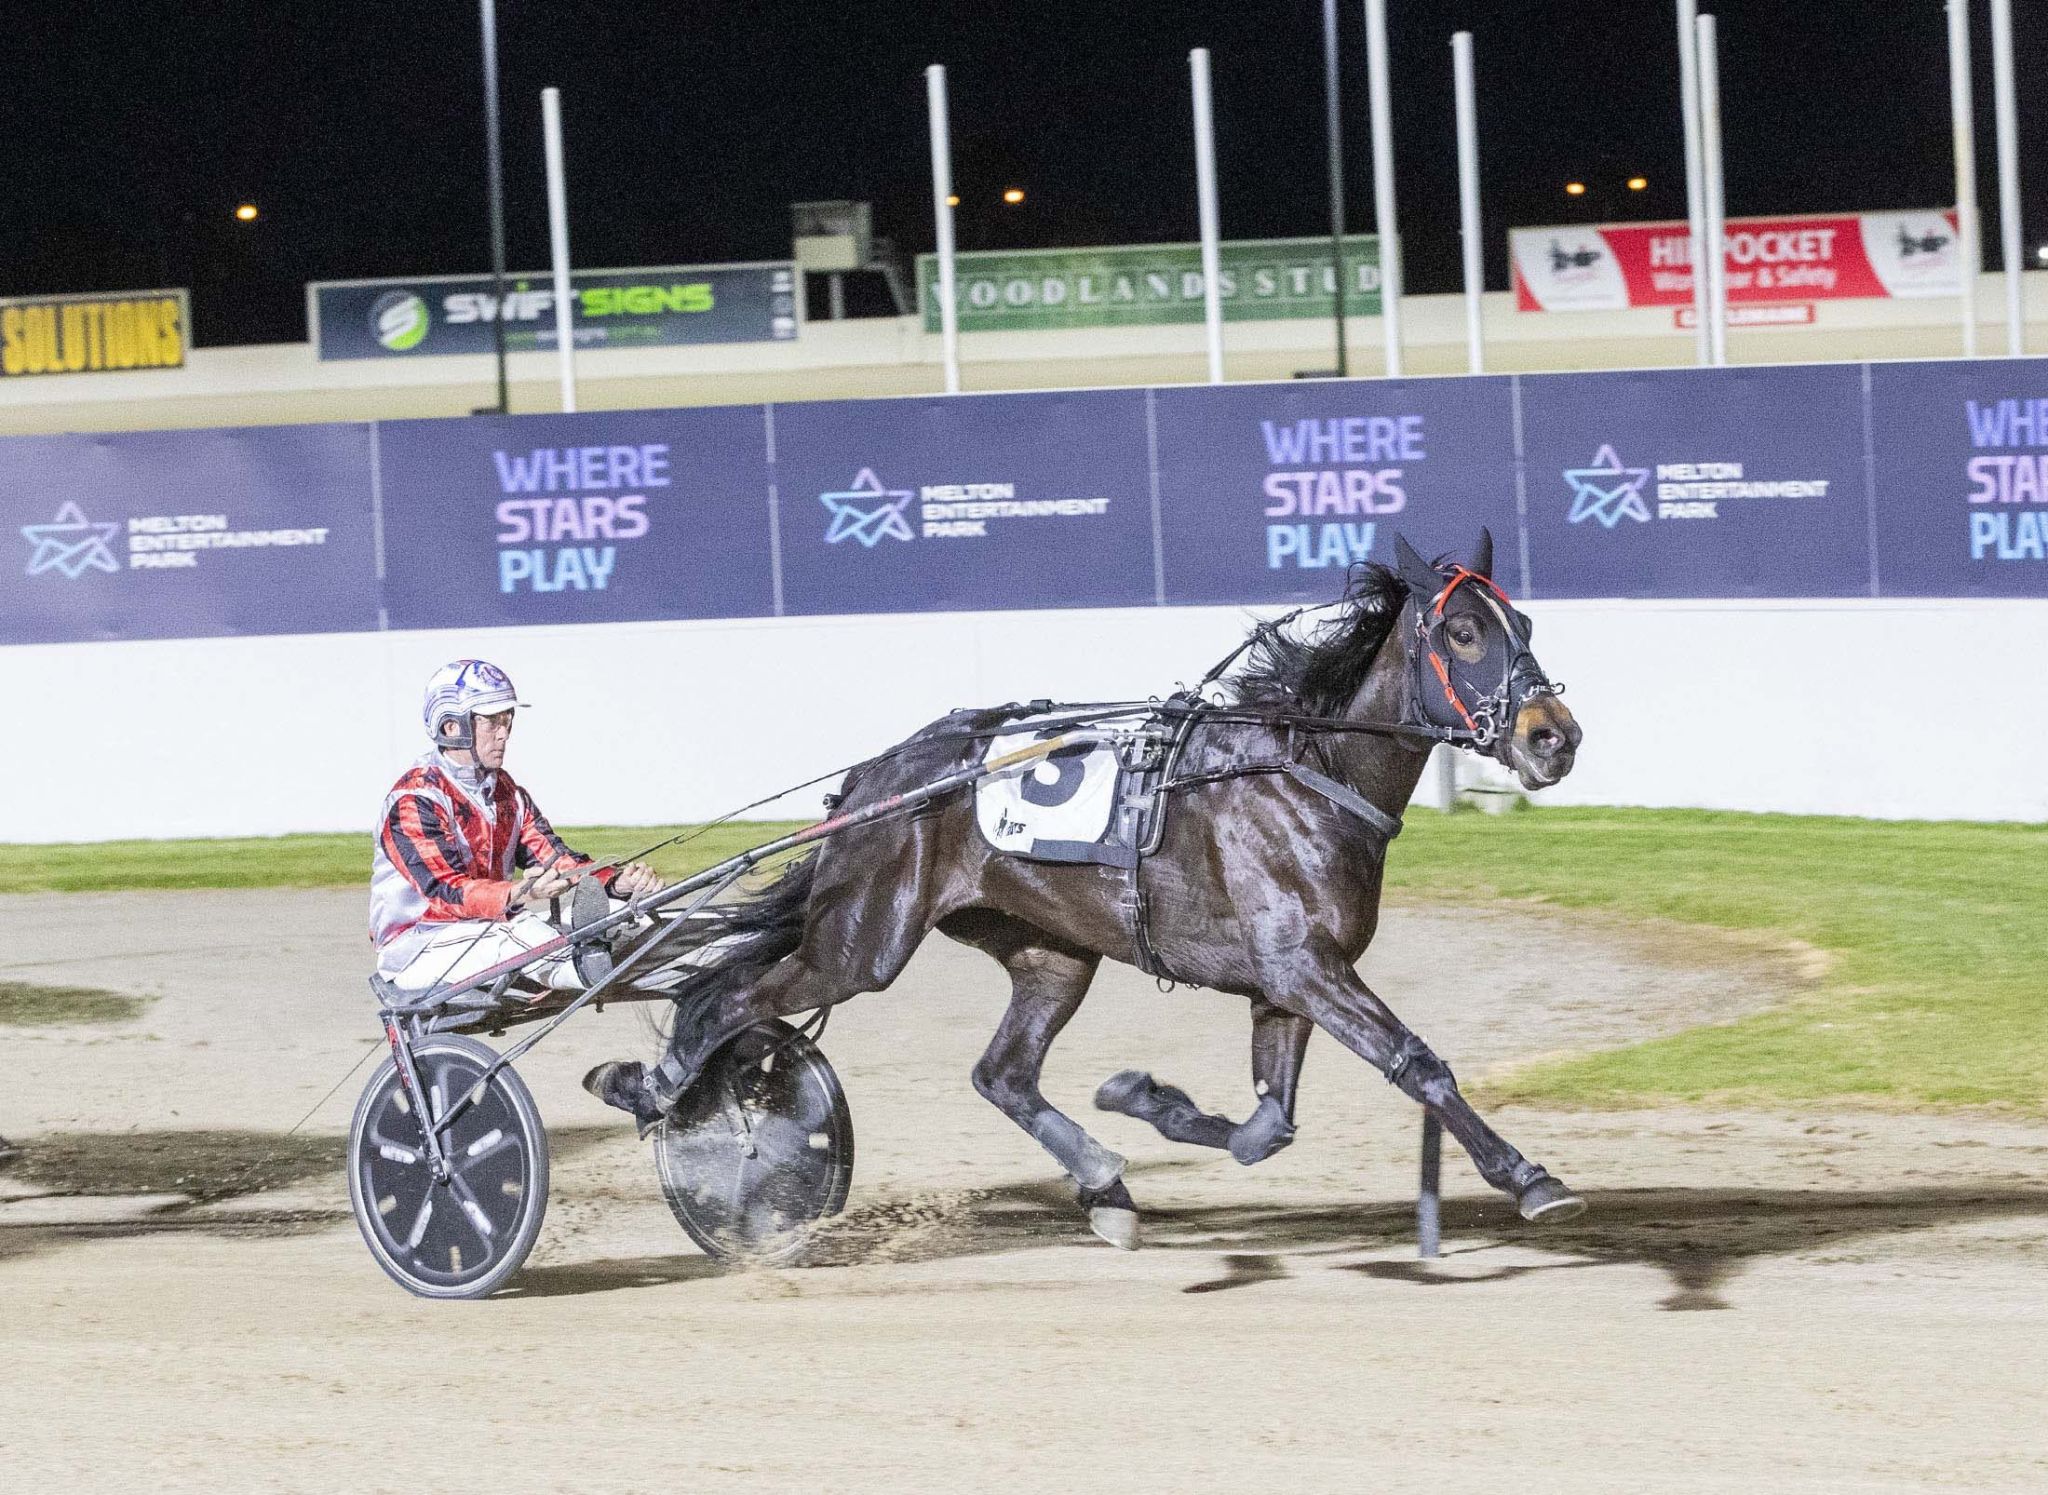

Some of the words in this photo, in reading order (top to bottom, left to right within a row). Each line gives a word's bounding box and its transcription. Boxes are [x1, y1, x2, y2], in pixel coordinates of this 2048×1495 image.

[1716, 229, 1836, 264] OCKET
[580, 283, 714, 318] SIGNS
[3, 299, 182, 374] SOLUTIONS
[1262, 416, 1425, 464] WHERE
[494, 444, 670, 492] WHERE
[1656, 463, 1742, 480] MELTON
[921, 483, 1014, 501] MELTON
[1264, 469, 1405, 517] STARS
[1657, 480, 1828, 500] ENTERTAINMENT
[128, 514, 227, 533] MELTON
[496, 495, 649, 543] STARS
[922, 498, 1108, 520] ENTERTAINMENT
[1658, 502, 1717, 519] PARK
[129, 528, 328, 551] ENTERTAINMENT
[923, 520, 986, 538] PARK
[130, 551, 197, 569] PARK
[1267, 522, 1375, 569] PLAY
[500, 547, 615, 592] PLAY
